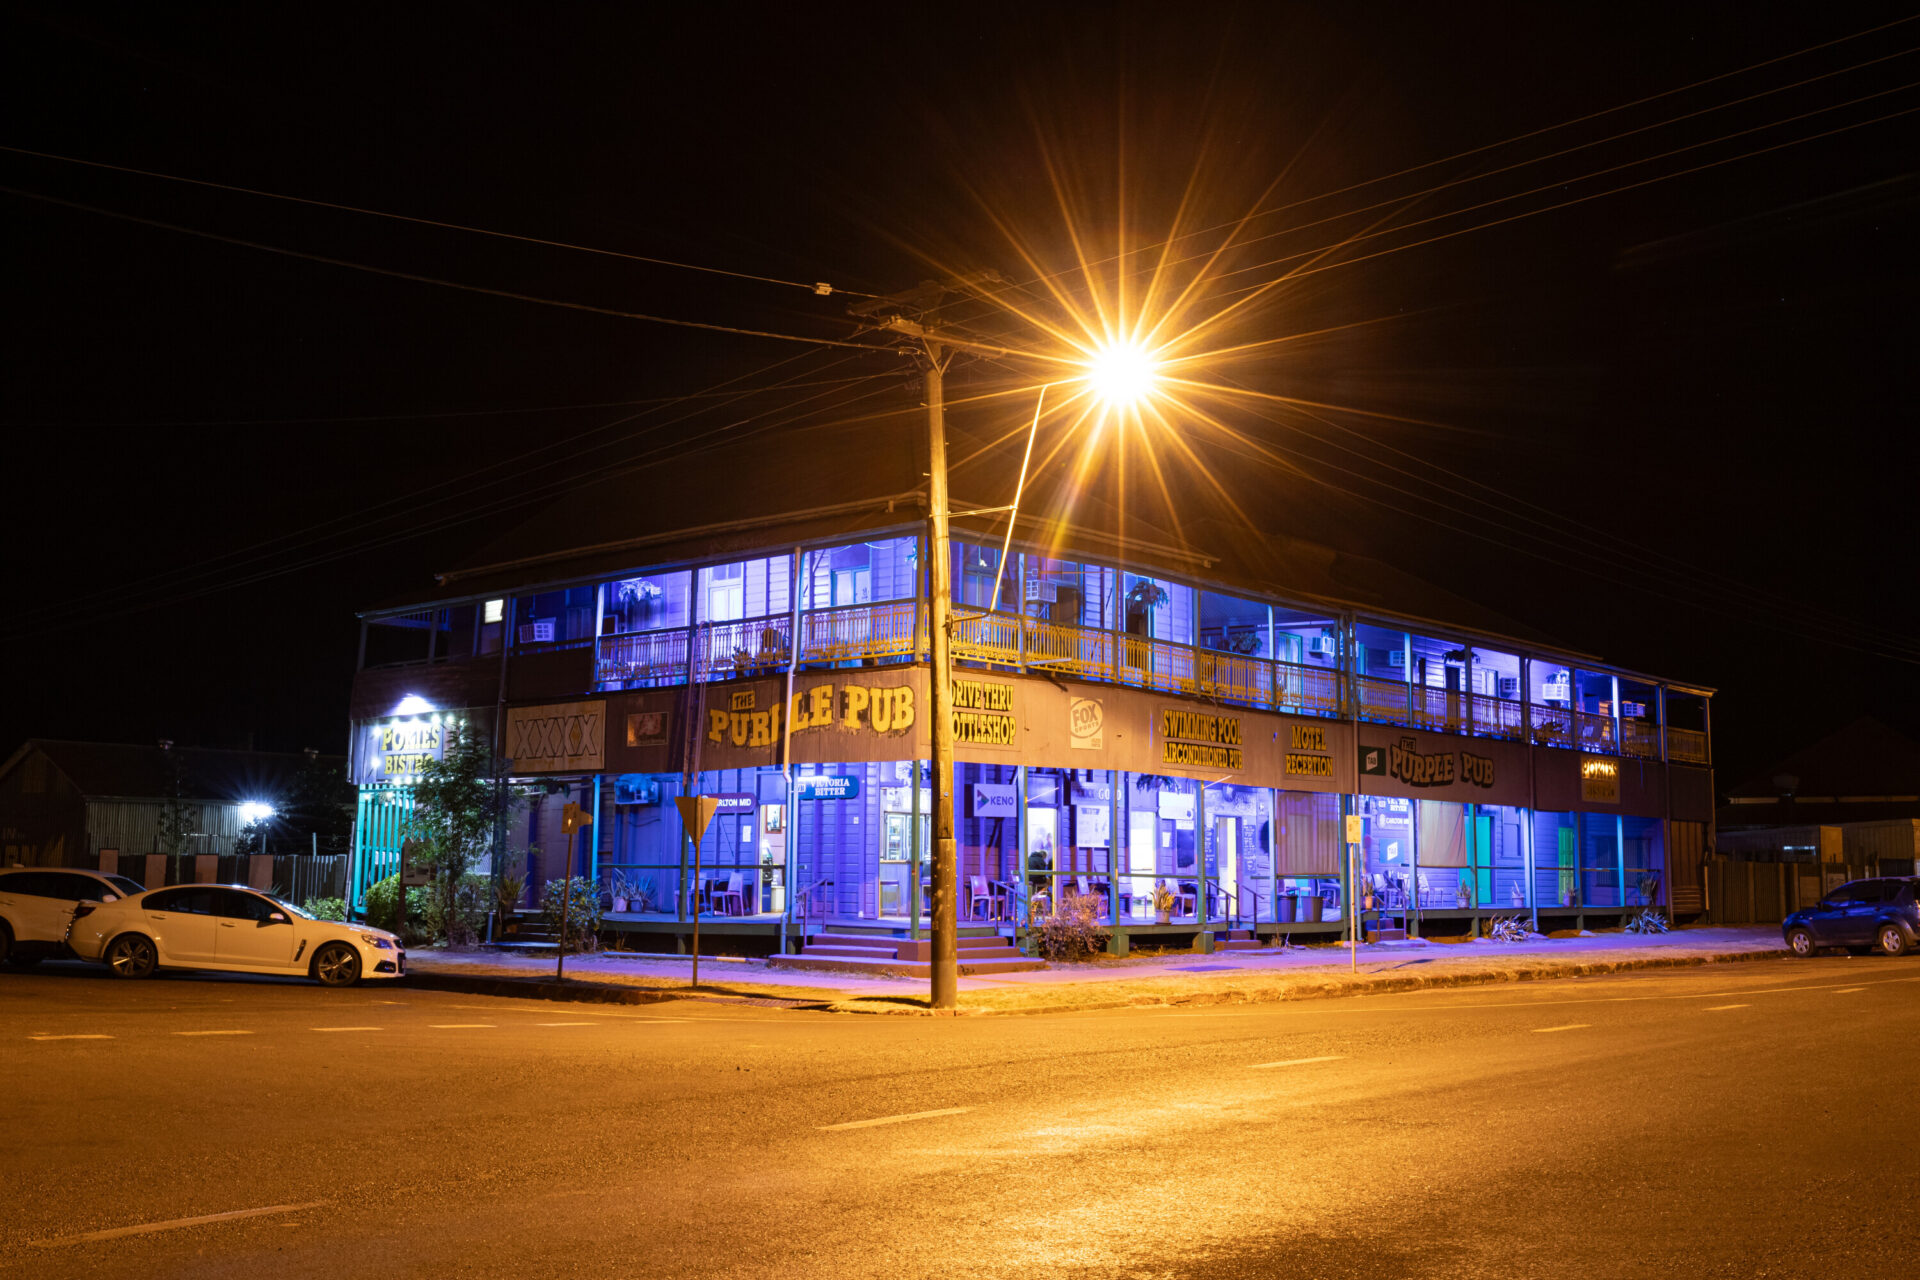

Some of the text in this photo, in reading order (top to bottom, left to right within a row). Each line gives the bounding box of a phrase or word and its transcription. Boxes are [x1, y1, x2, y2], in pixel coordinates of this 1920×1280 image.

[734, 692, 755, 708] THE
[983, 682, 1014, 711] THRU
[844, 685, 915, 733] PUB
[1072, 703, 1098, 727] FOX
[513, 714, 598, 760] XXXX
[952, 711, 1016, 745] OTTLESHOP
[1163, 709, 1243, 745] SWIMMING POOL
[1291, 725, 1327, 750] MOTEL
[1163, 742, 1243, 769] AIRCONDITIONED PUB
[1402, 740, 1415, 750] THE
[1285, 754, 1333, 776] RECEPTION
[1391, 745, 1494, 786] PURPLE PUB
[810, 778, 850, 787] VICTORIA
[815, 787, 845, 796] BITTER
[1098, 787, 1122, 800] GOD
[717, 798, 752, 807] RLTON MID
[990, 795, 1014, 806] KENO
